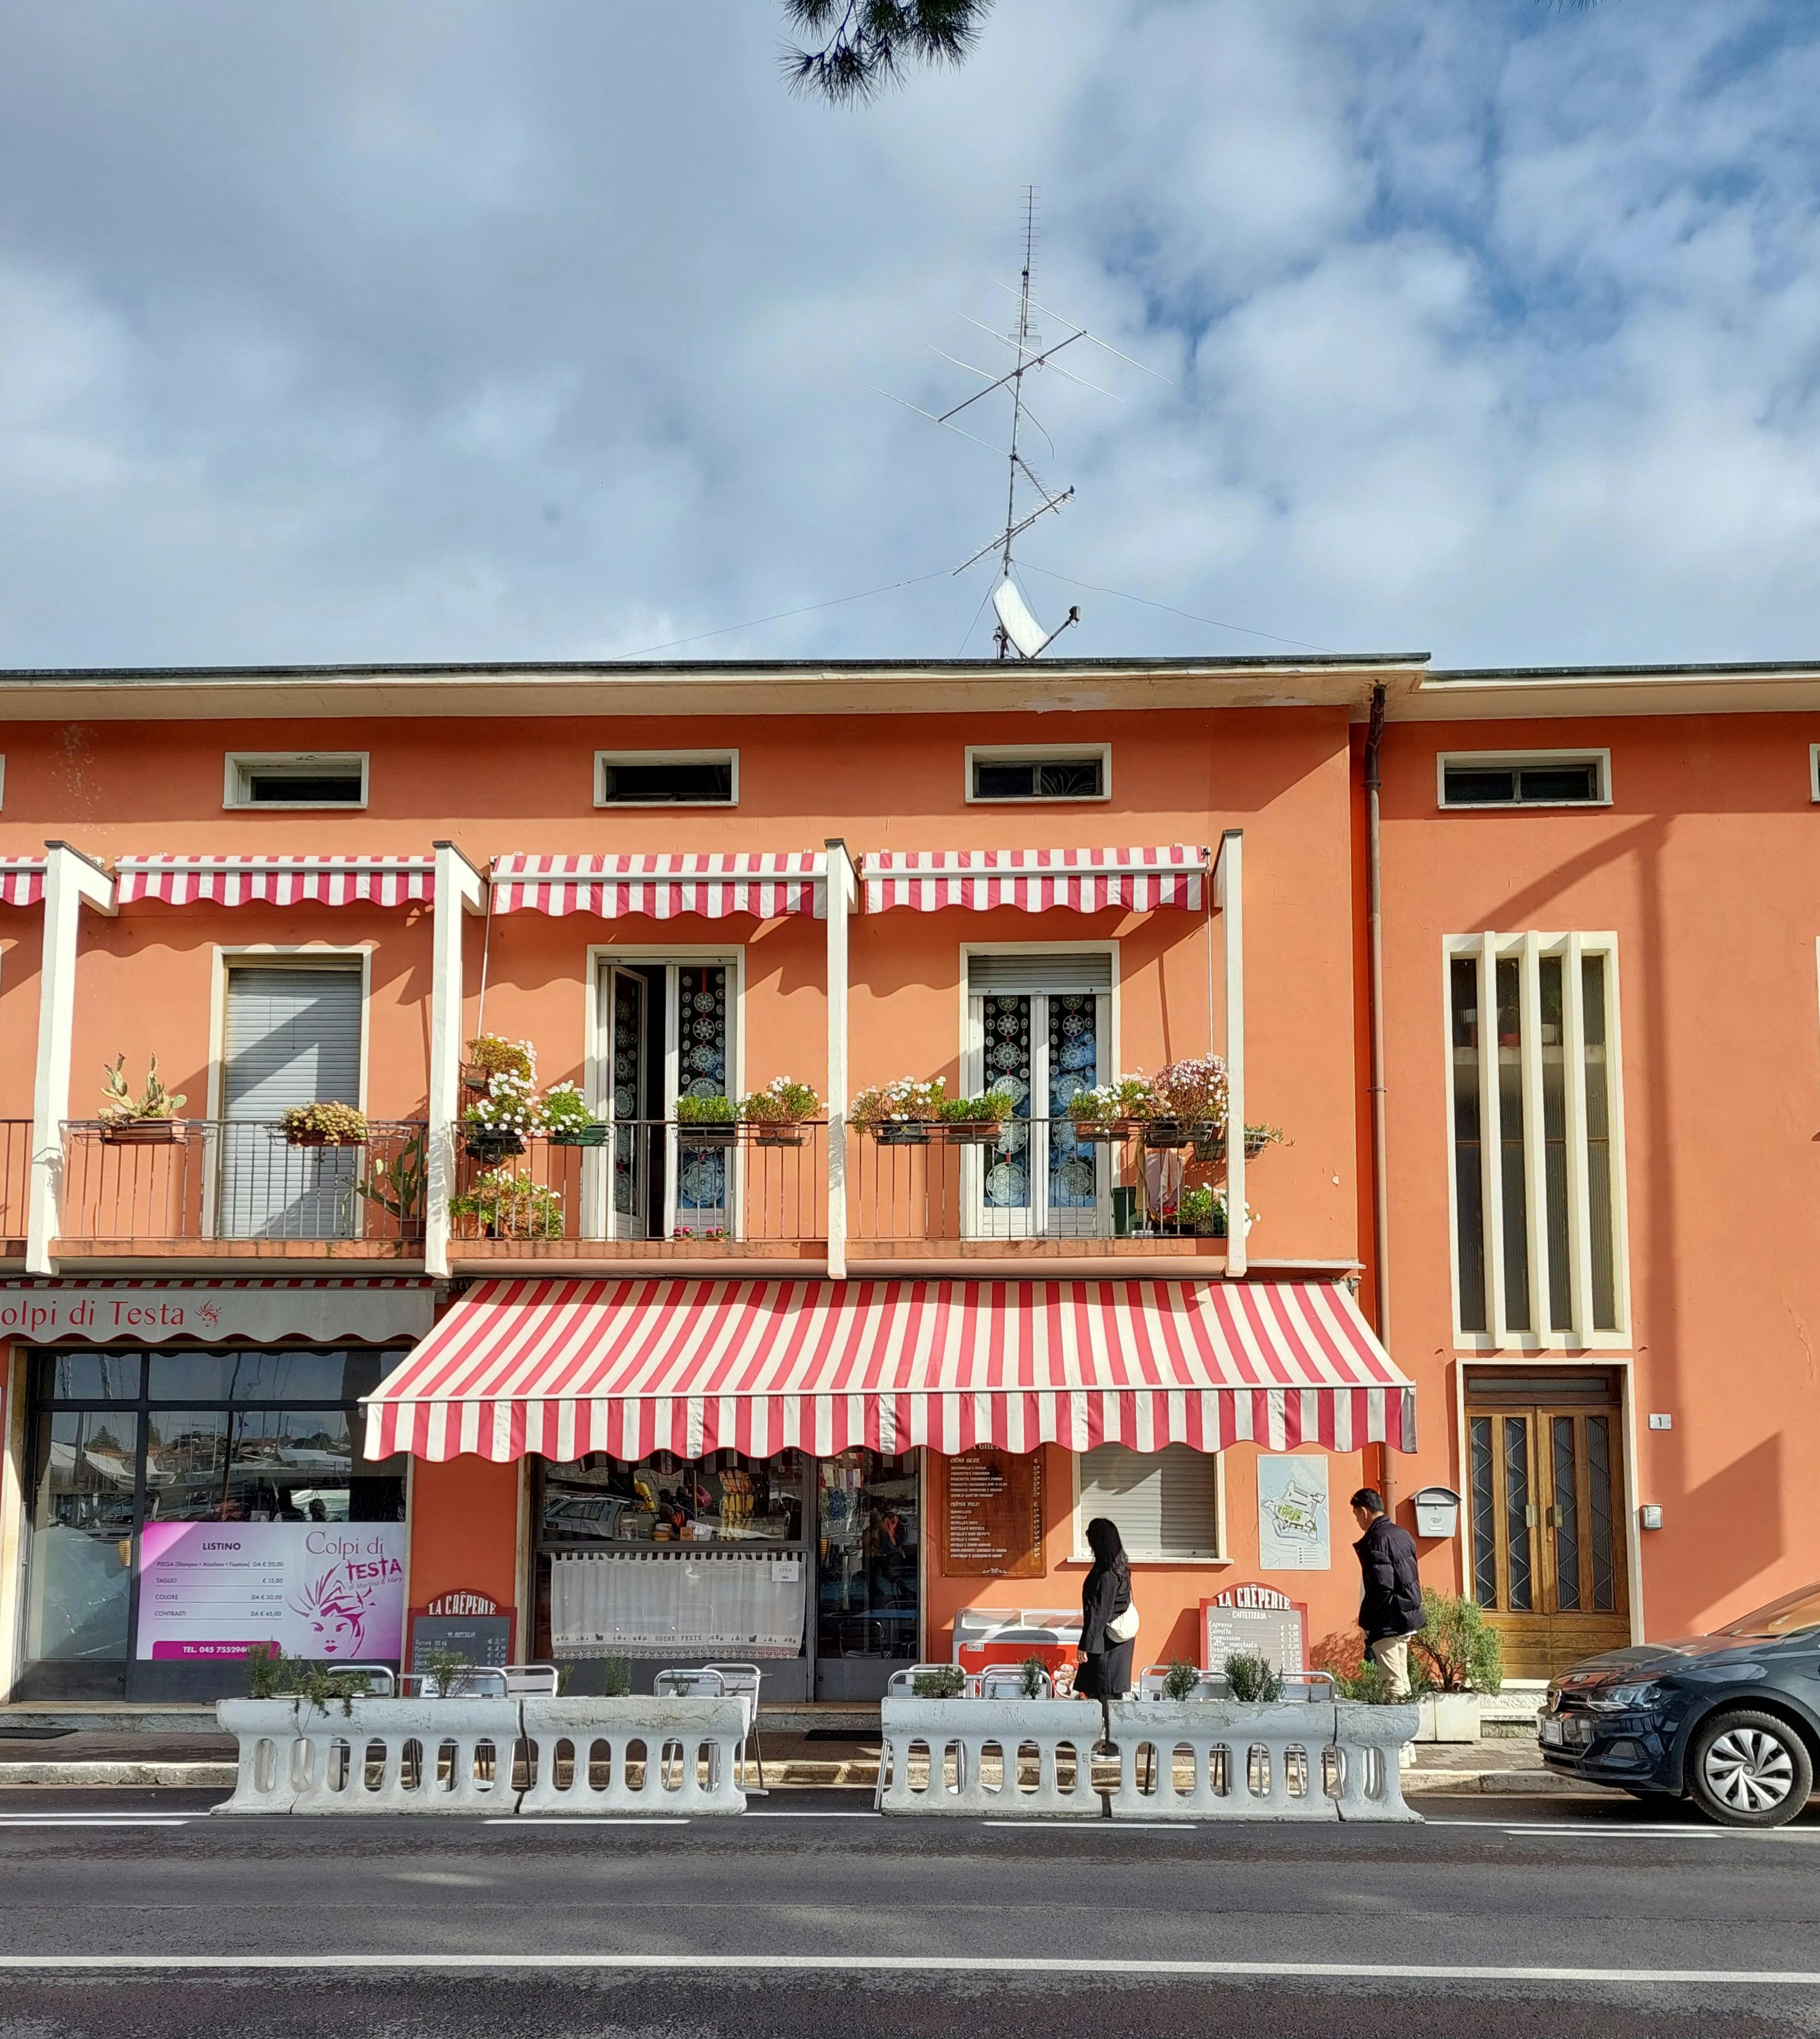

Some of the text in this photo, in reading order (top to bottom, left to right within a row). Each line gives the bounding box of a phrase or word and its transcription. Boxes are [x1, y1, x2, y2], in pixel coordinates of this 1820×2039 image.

[69, 1299, 95, 1325] di
[108, 1300, 184, 1325] Testa
[1657, 1416, 1662, 1427] 1
[305, 1531, 384, 1560] Colpi di
[345, 1554, 402, 1584] TESTA
[428, 1591, 497, 1615] LA CRÊPERIE
[1218, 1583, 1291, 1611] LA CRÊPERIE
[1208, 1620, 1233, 1629] Espresso
